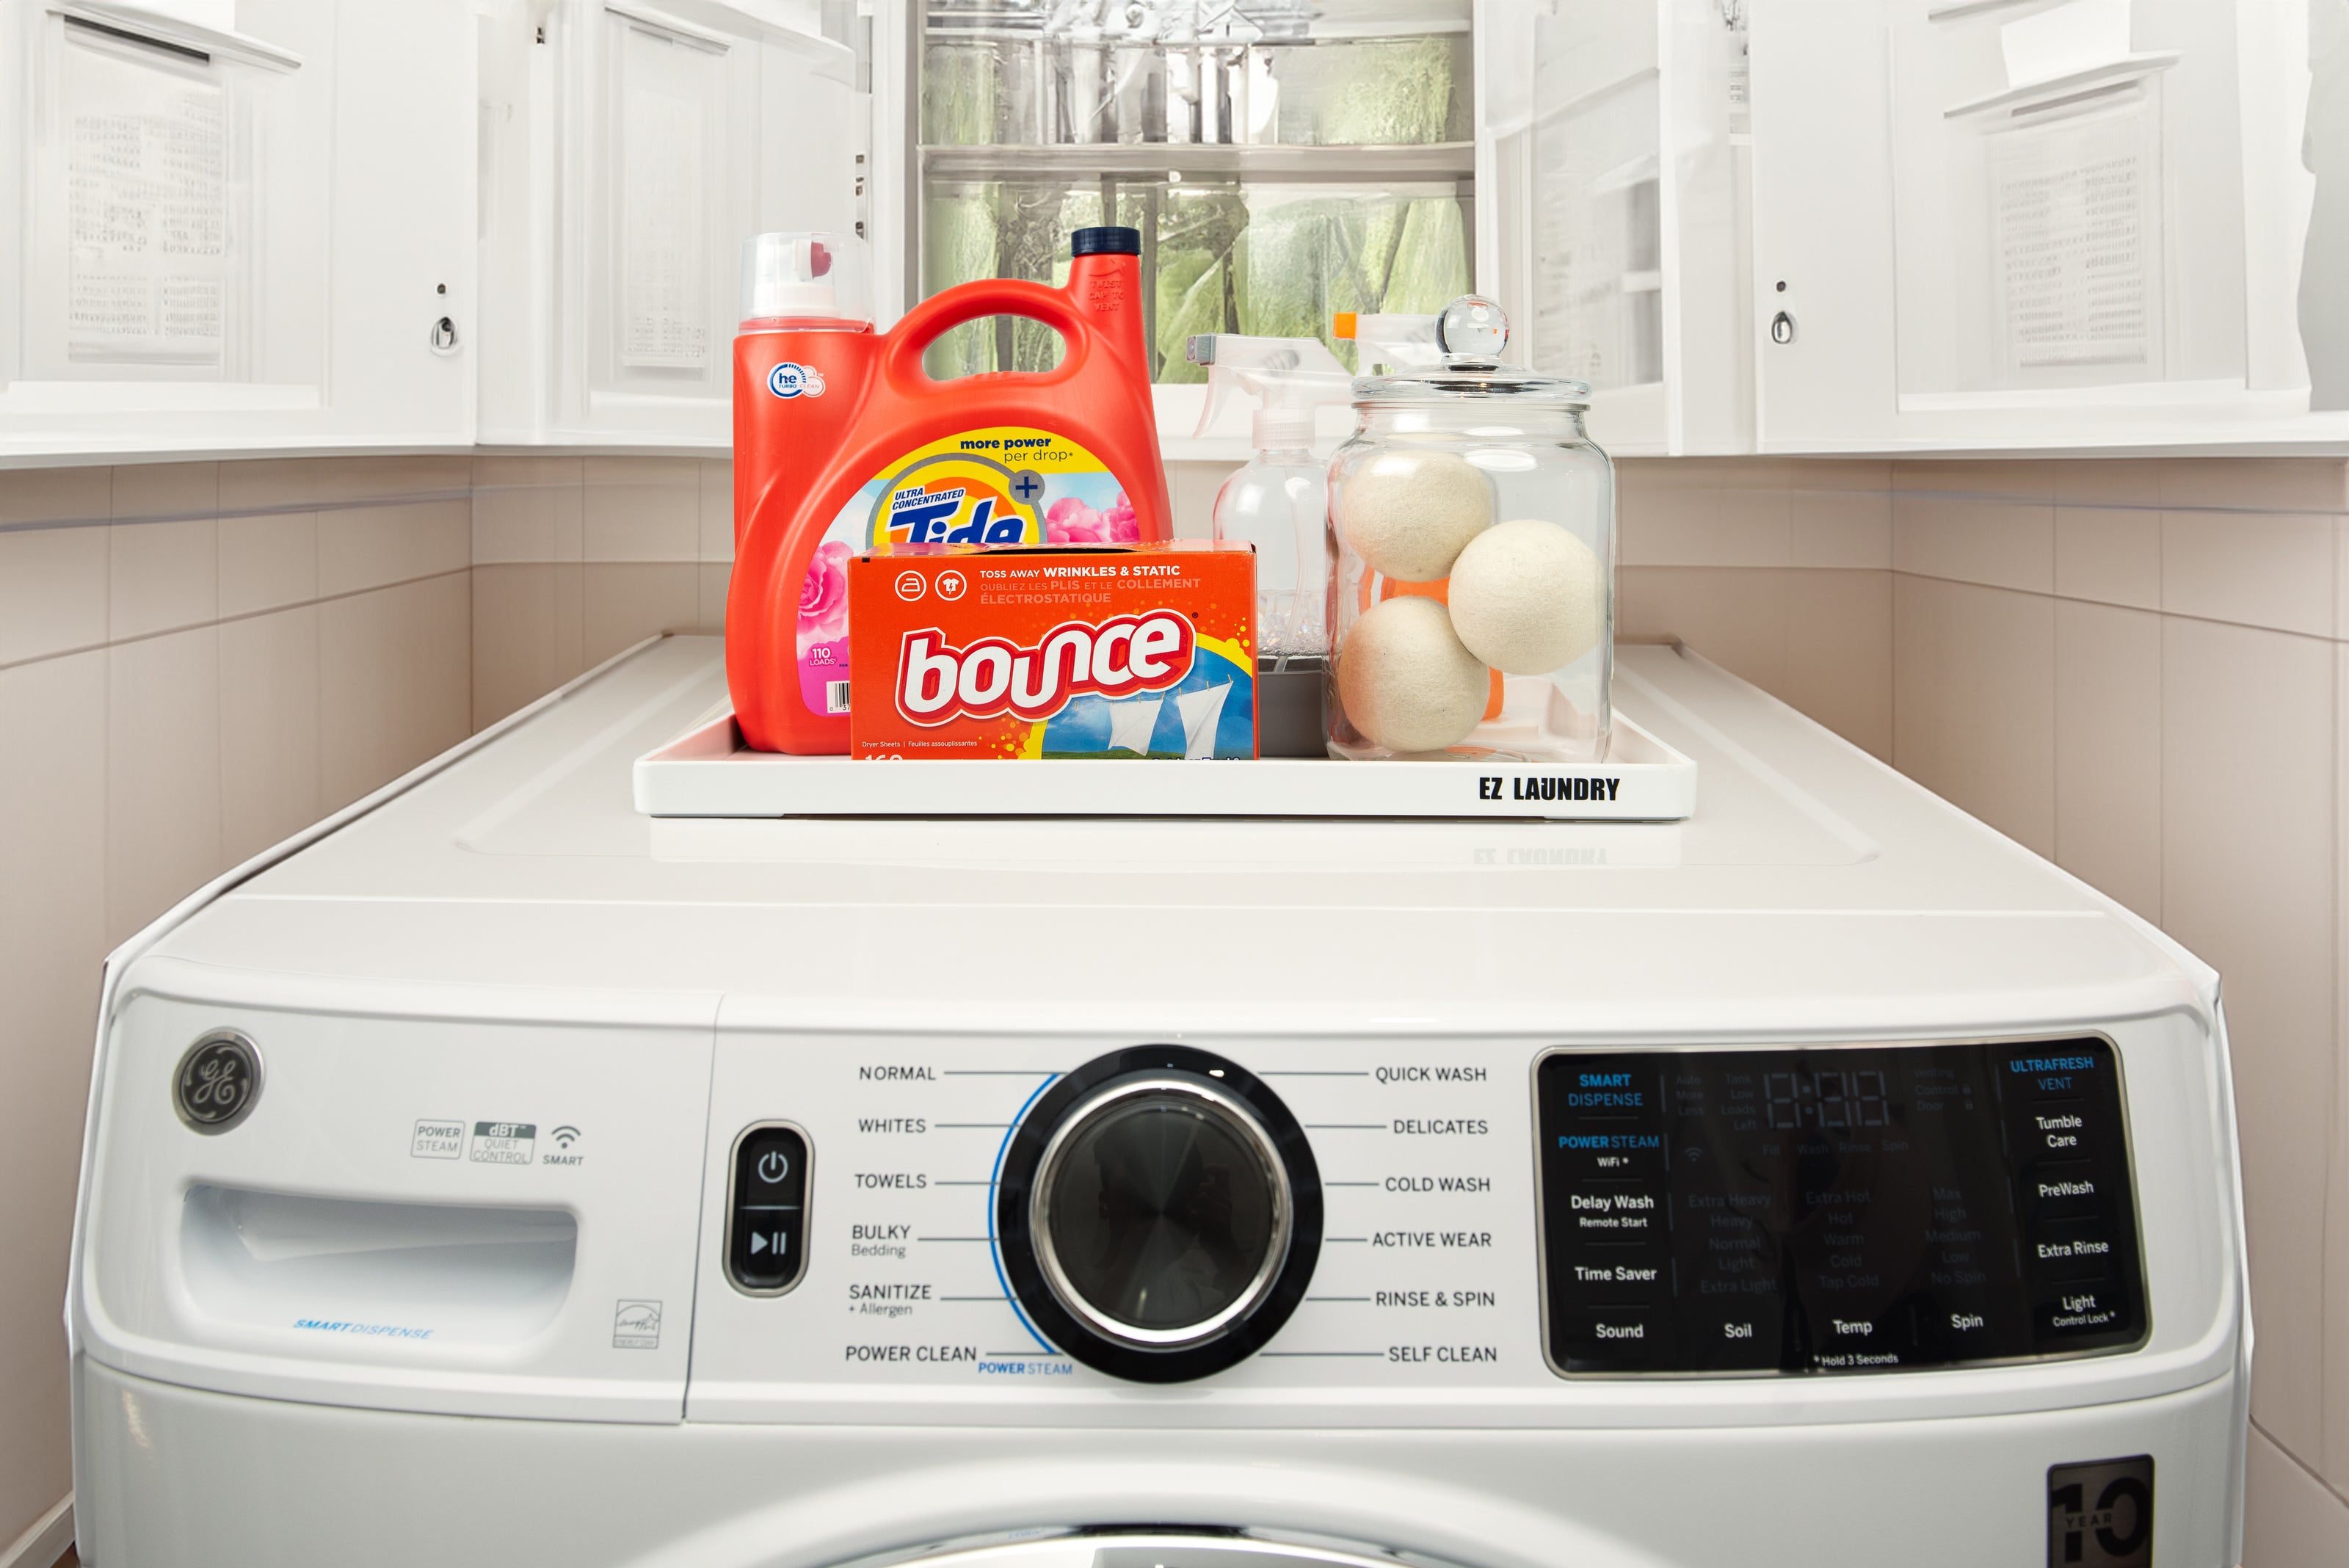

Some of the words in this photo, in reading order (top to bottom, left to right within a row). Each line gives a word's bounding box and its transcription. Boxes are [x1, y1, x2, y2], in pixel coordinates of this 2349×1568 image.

[1089, 291, 1107, 300] CAP
[1112, 291, 1125, 300] TO
[1094, 302, 1119, 311] VENT
[779, 373, 796, 383] he
[960, 439, 1000, 449] more
[1004, 438, 1051, 450] power
[1004, 451, 1028, 463] per
[892, 488, 965, 510] CONCENTRATED
[895, 487, 923, 501] ULTRA
[980, 570, 1006, 578] TOSS
[1009, 570, 1039, 578] AWAY
[1043, 566, 1117, 578] WRINKLES
[1120, 567, 1129, 576] &
[1133, 565, 1180, 576] STATIC
[980, 582, 1025, 591] OUBLIEZ
[1028, 582, 1048, 591] LES
[1050, 580, 1081, 590] PLIS
[1100, 581, 1113, 589] LE
[1117, 578, 1201, 589] COLLEMENT
[980, 592, 1111, 605] ÉLECTROSTATIQUE
[812, 647, 831, 658] 110
[900, 613, 1189, 721] bounce
[1479, 777, 1503, 800] EZ
[1514, 777, 1620, 801] LAUNDRY
[2010, 1057, 2094, 1073] ULTRAFRESH
[859, 1067, 936, 1081] NORMAL
[1376, 1067, 1430, 1084] QUICK
[1436, 1067, 1486, 1081] WASH
[1580, 1074, 1631, 1088] SMART
[1676, 1075, 1702, 1085] Auto
[1724, 1074, 1752, 1084] Tank
[193, 1059, 236, 1106] GE
[2038, 1077, 2072, 1090] VENT
[1676, 1090, 1703, 1100] More
[1731, 1089, 1754, 1099] Low
[1914, 1085, 1958, 1095] Control
[1568, 1092, 1643, 1107] DISPENSE
[1917, 1100, 1944, 1111] Door
[1678, 1106, 1704, 1116] Less
[1721, 1105, 1756, 1116] Loads
[859, 1119, 926, 1133] WHITES
[1394, 1119, 1488, 1134] DELICATES
[1734, 1119, 1757, 1130] Left
[2036, 1115, 2083, 1130] Tumble
[418, 1126, 461, 1138] POWER
[416, 1140, 458, 1152] STEAM
[484, 1139, 518, 1150] QUIET
[1558, 1136, 1609, 1148] POWER
[1611, 1135, 1660, 1148] STEAM
[1762, 1144, 1780, 1155] Fill
[1798, 1143, 1829, 1154] Wash
[1839, 1141, 1871, 1153] Rinse
[1882, 1139, 1909, 1153] Spin
[2047, 1135, 2077, 1148] Care
[473, 1150, 527, 1164] CONTROL
[542, 1155, 584, 1166] SMART
[1597, 1157, 1620, 1168] WiFi
[854, 1174, 927, 1188] TOWELS
[1385, 1177, 1434, 1192] COLD
[1439, 1177, 1490, 1192] WASH
[1934, 1187, 1962, 1199] Max
[2038, 1181, 2094, 1198] PreWash
[1571, 1195, 1611, 1212] Delay
[1614, 1194, 1654, 1210] Wash
[1688, 1195, 1725, 1208] Extra
[1729, 1194, 1771, 1208] Heavy
[1807, 1191, 1842, 1205] Extra
[1846, 1190, 1871, 1202] Hot
[1829, 1213, 1854, 1224] Hot
[1934, 1208, 1967, 1222] High
[1580, 1217, 1619, 1228] Remote
[1621, 1217, 1647, 1228] Start
[1710, 1216, 1753, 1229] Heavy
[852, 1224, 911, 1240] BULKY
[1925, 1230, 1981, 1243] Medium
[1373, 1232, 1436, 1247] ACTIVE
[1440, 1232, 1492, 1246] WEAR
[1709, 1236, 1761, 1250] Normal
[1824, 1234, 1865, 1246] Warm
[852, 1244, 906, 1258] Bedding
[2038, 1244, 2072, 1258] Extra
[2074, 1241, 2109, 1255] Rinse
[1718, 1257, 1754, 1272] Light
[1830, 1255, 1862, 1267] Cold
[1942, 1252, 1969, 1263] Low
[1575, 1266, 1611, 1281] Time
[1615, 1266, 1657, 1281] Saver
[1931, 1272, 1952, 1284] No
[1954, 1271, 1986, 1286] Spin
[1700, 1280, 1737, 1293] Extra
[1741, 1279, 1777, 1293] Light
[1819, 1276, 1844, 1289] Tap
[1847, 1274, 1879, 1288] Cold
[849, 1285, 932, 1300] SANITIZE
[1376, 1291, 1430, 1307] RINSE
[1436, 1292, 1448, 1307] &
[1453, 1291, 1495, 1307] SPIN
[860, 1302, 912, 1318] Allergen
[2063, 1296, 2096, 1313] Light
[1951, 1314, 1983, 1331] Spin
[2052, 1315, 2086, 1327] Control
[2087, 1314, 2109, 1325] Lock
[1596, 1324, 1644, 1339] Sound
[1724, 1324, 1752, 1338] Soil
[1833, 1320, 1873, 1337] Temp
[846, 1346, 910, 1362] POWER
[916, 1346, 977, 1362] CLEAN
[1390, 1347, 1431, 1362] SELF
[1437, 1347, 1497, 1362] CLEAN
[1823, 1356, 1845, 1367] Hold
[1848, 1355, 1854, 1365] 3
[1857, 1353, 1898, 1366] Seconds
[979, 1362, 1025, 1375] POWER
[1028, 1363, 1072, 1376] STEAM
[2066, 1513, 2113, 1528] YEAR
